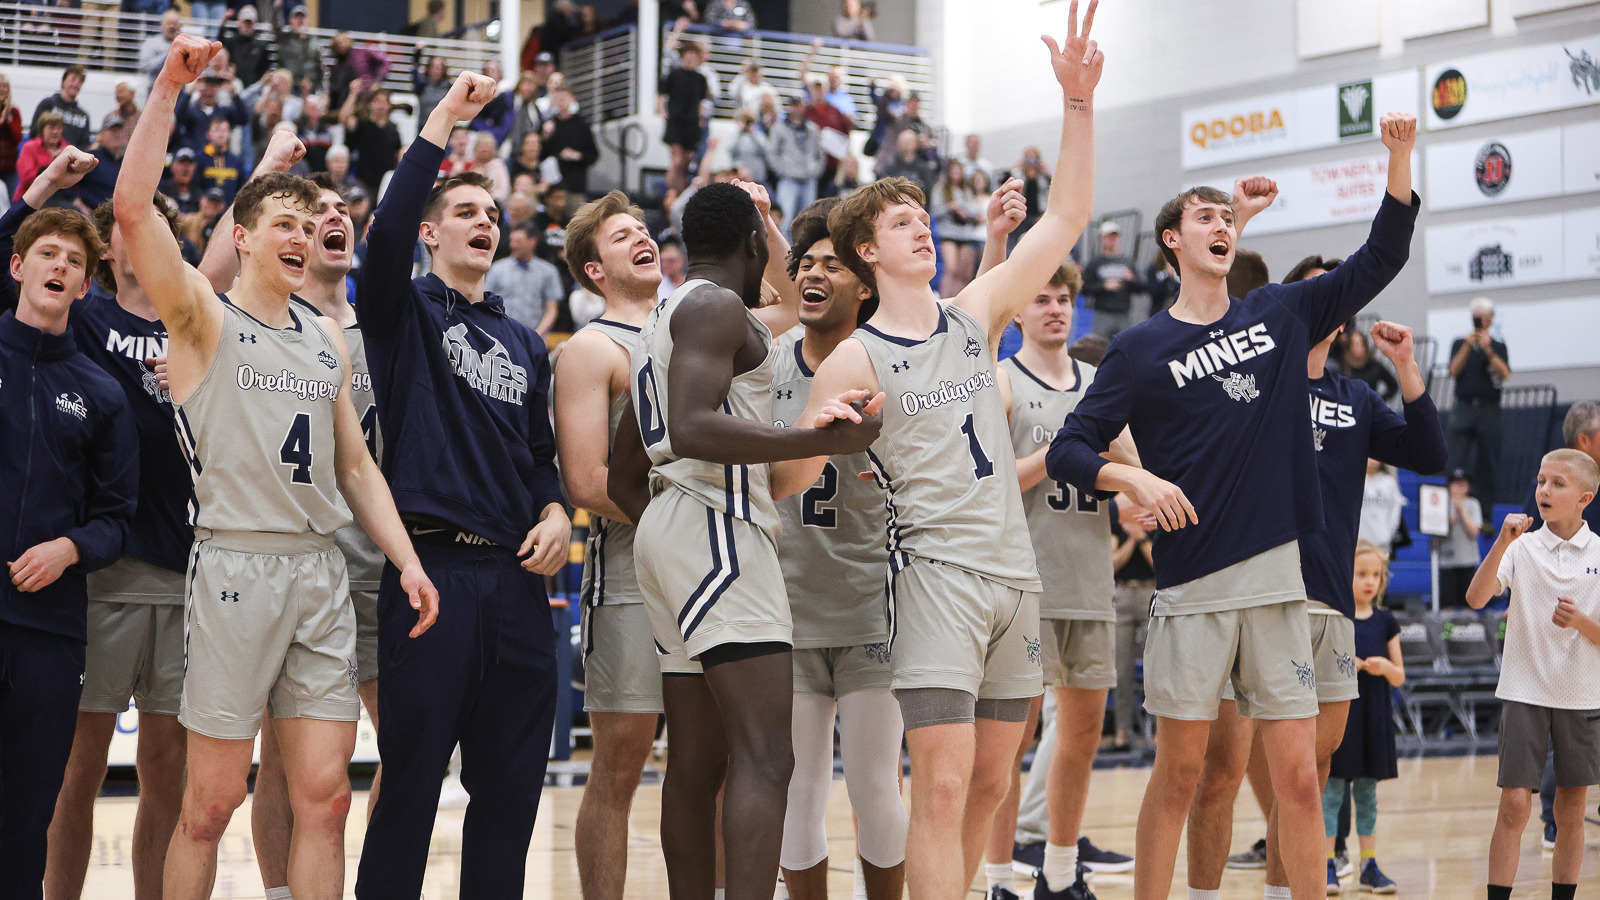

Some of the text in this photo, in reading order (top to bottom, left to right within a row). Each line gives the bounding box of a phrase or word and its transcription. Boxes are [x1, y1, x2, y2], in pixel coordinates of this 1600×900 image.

[1191, 110, 1284, 149] QDOBA
[1311, 161, 1387, 184] TOWNEPLA
[106, 328, 168, 360] MIN
[1167, 322, 1276, 388] MINES
[55, 396, 88, 419] MINES
[900, 369, 994, 416] Orediggers
[1308, 394, 1356, 428] NES
[279, 412, 313, 486] 4
[958, 412, 995, 482] 1
[802, 460, 839, 529] 2
[455, 531, 499, 546] NIK
